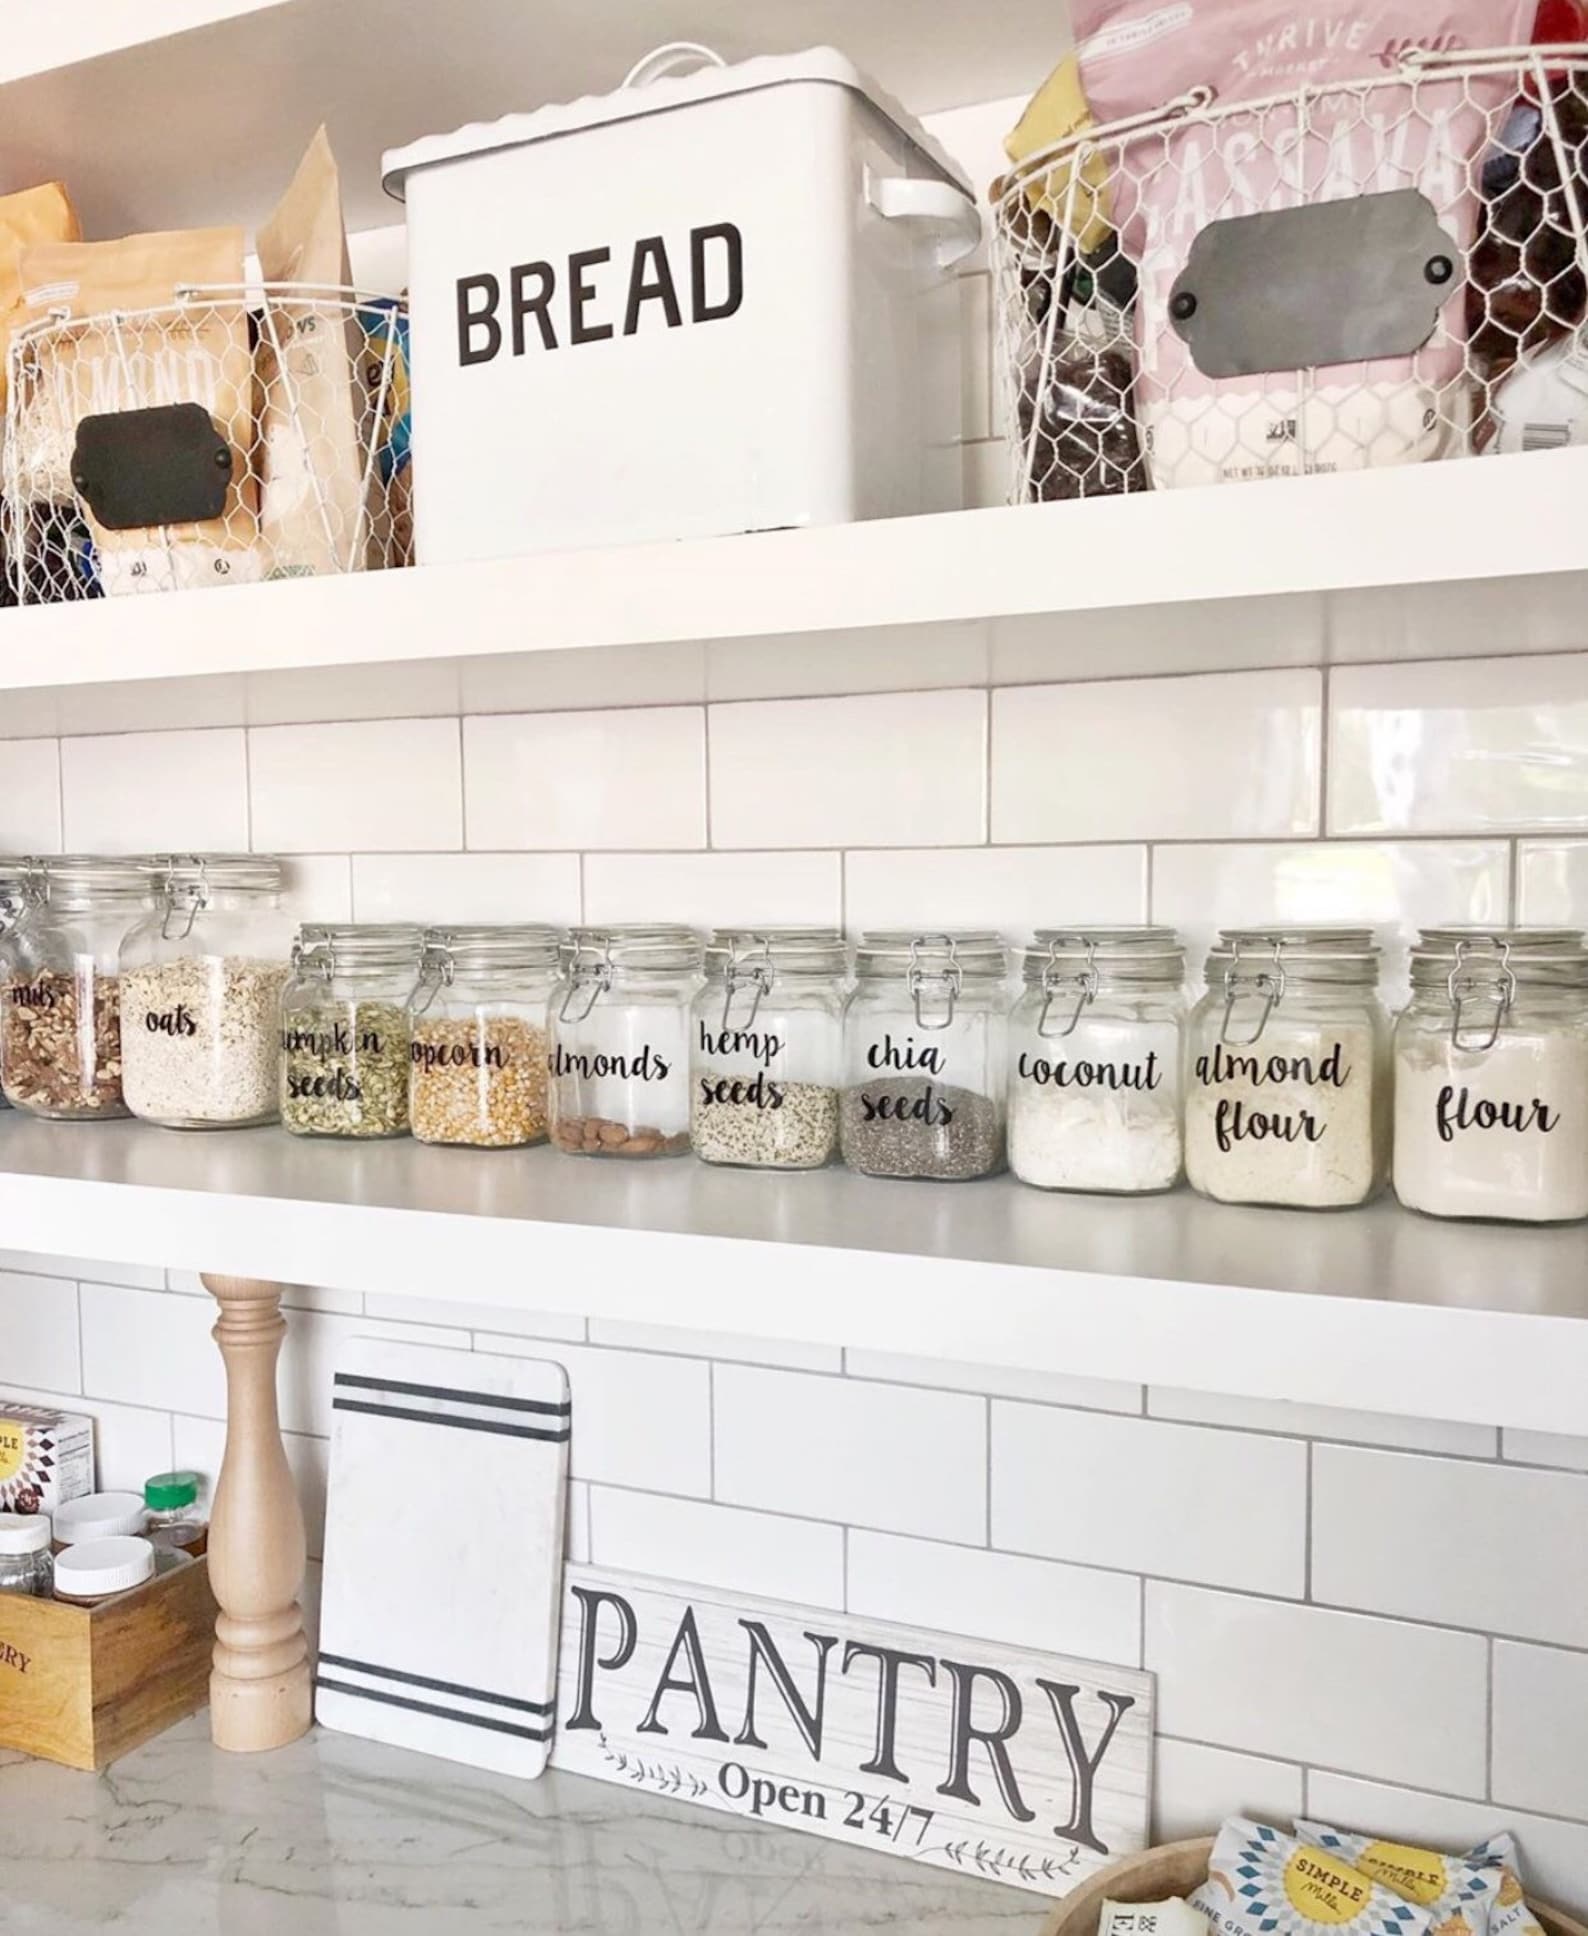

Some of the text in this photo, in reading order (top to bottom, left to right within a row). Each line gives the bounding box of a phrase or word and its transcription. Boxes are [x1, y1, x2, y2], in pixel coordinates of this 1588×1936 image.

[1146, 106, 1458, 236] ASSAVA
[455, 221, 744, 368] BREAD
[145, 1003, 197, 1038] oats
[700, 1020, 785, 1067] hemp
[867, 1034, 946, 1076] chia
[1195, 1042, 1352, 1088] almond
[287, 1067, 362, 1101] seeds
[700, 1071, 785, 1110] seeds
[1018, 1051, 1163, 1091] coconut
[861, 1086, 956, 1126] seeds
[1215, 1098, 1328, 1152] flour
[1435, 1085, 1561, 1143] flour
[0, 1435, 19, 1450] LE
[565, 1584, 1137, 1856] PANTRY
[717, 1760, 935, 1847] Open 24/7
[1295, 1858, 1364, 1903] SIMPLE
[1490, 1906, 1521, 1935] SALT
